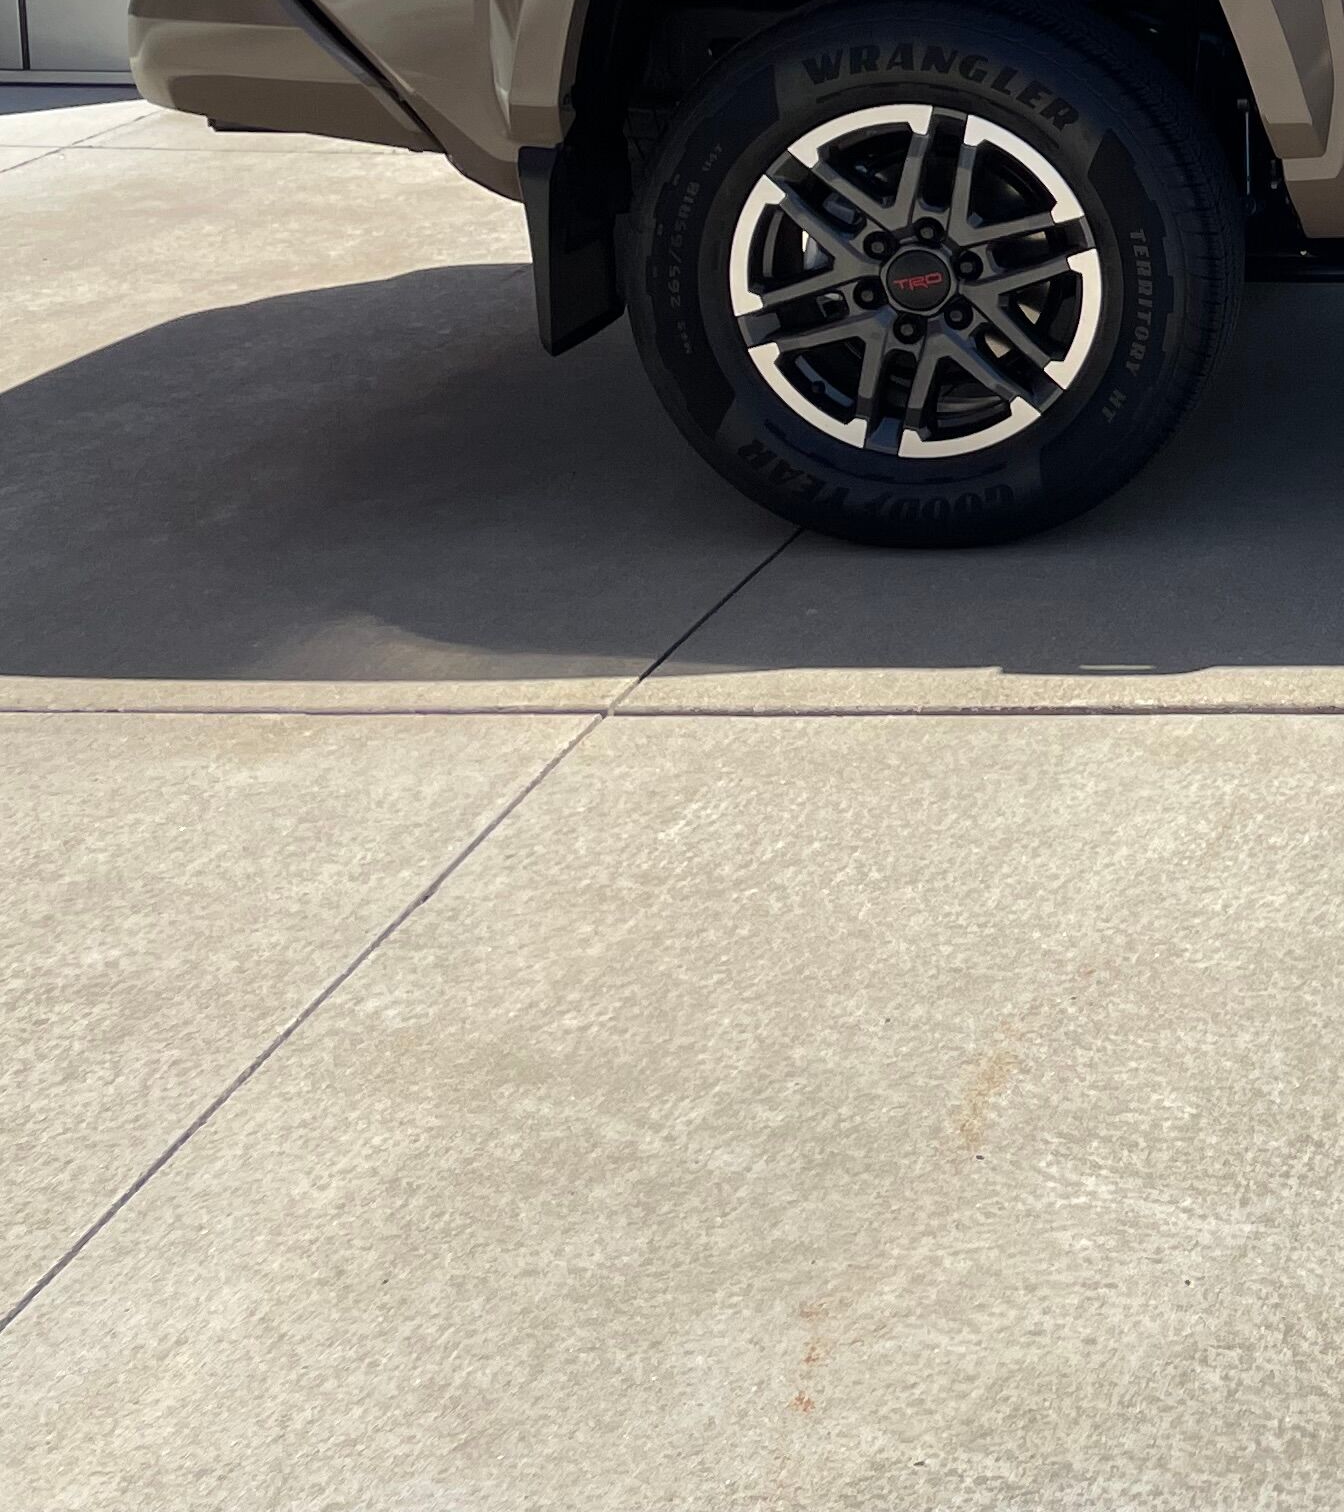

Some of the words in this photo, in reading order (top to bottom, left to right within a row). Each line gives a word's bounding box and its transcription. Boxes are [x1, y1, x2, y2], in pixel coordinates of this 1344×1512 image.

[800, 38, 1083, 136] WRANGLER
[893, 272, 942, 291] TRD
[1121, 227, 1152, 377] TERRITORY
[1097, 387, 1128, 425] HT
